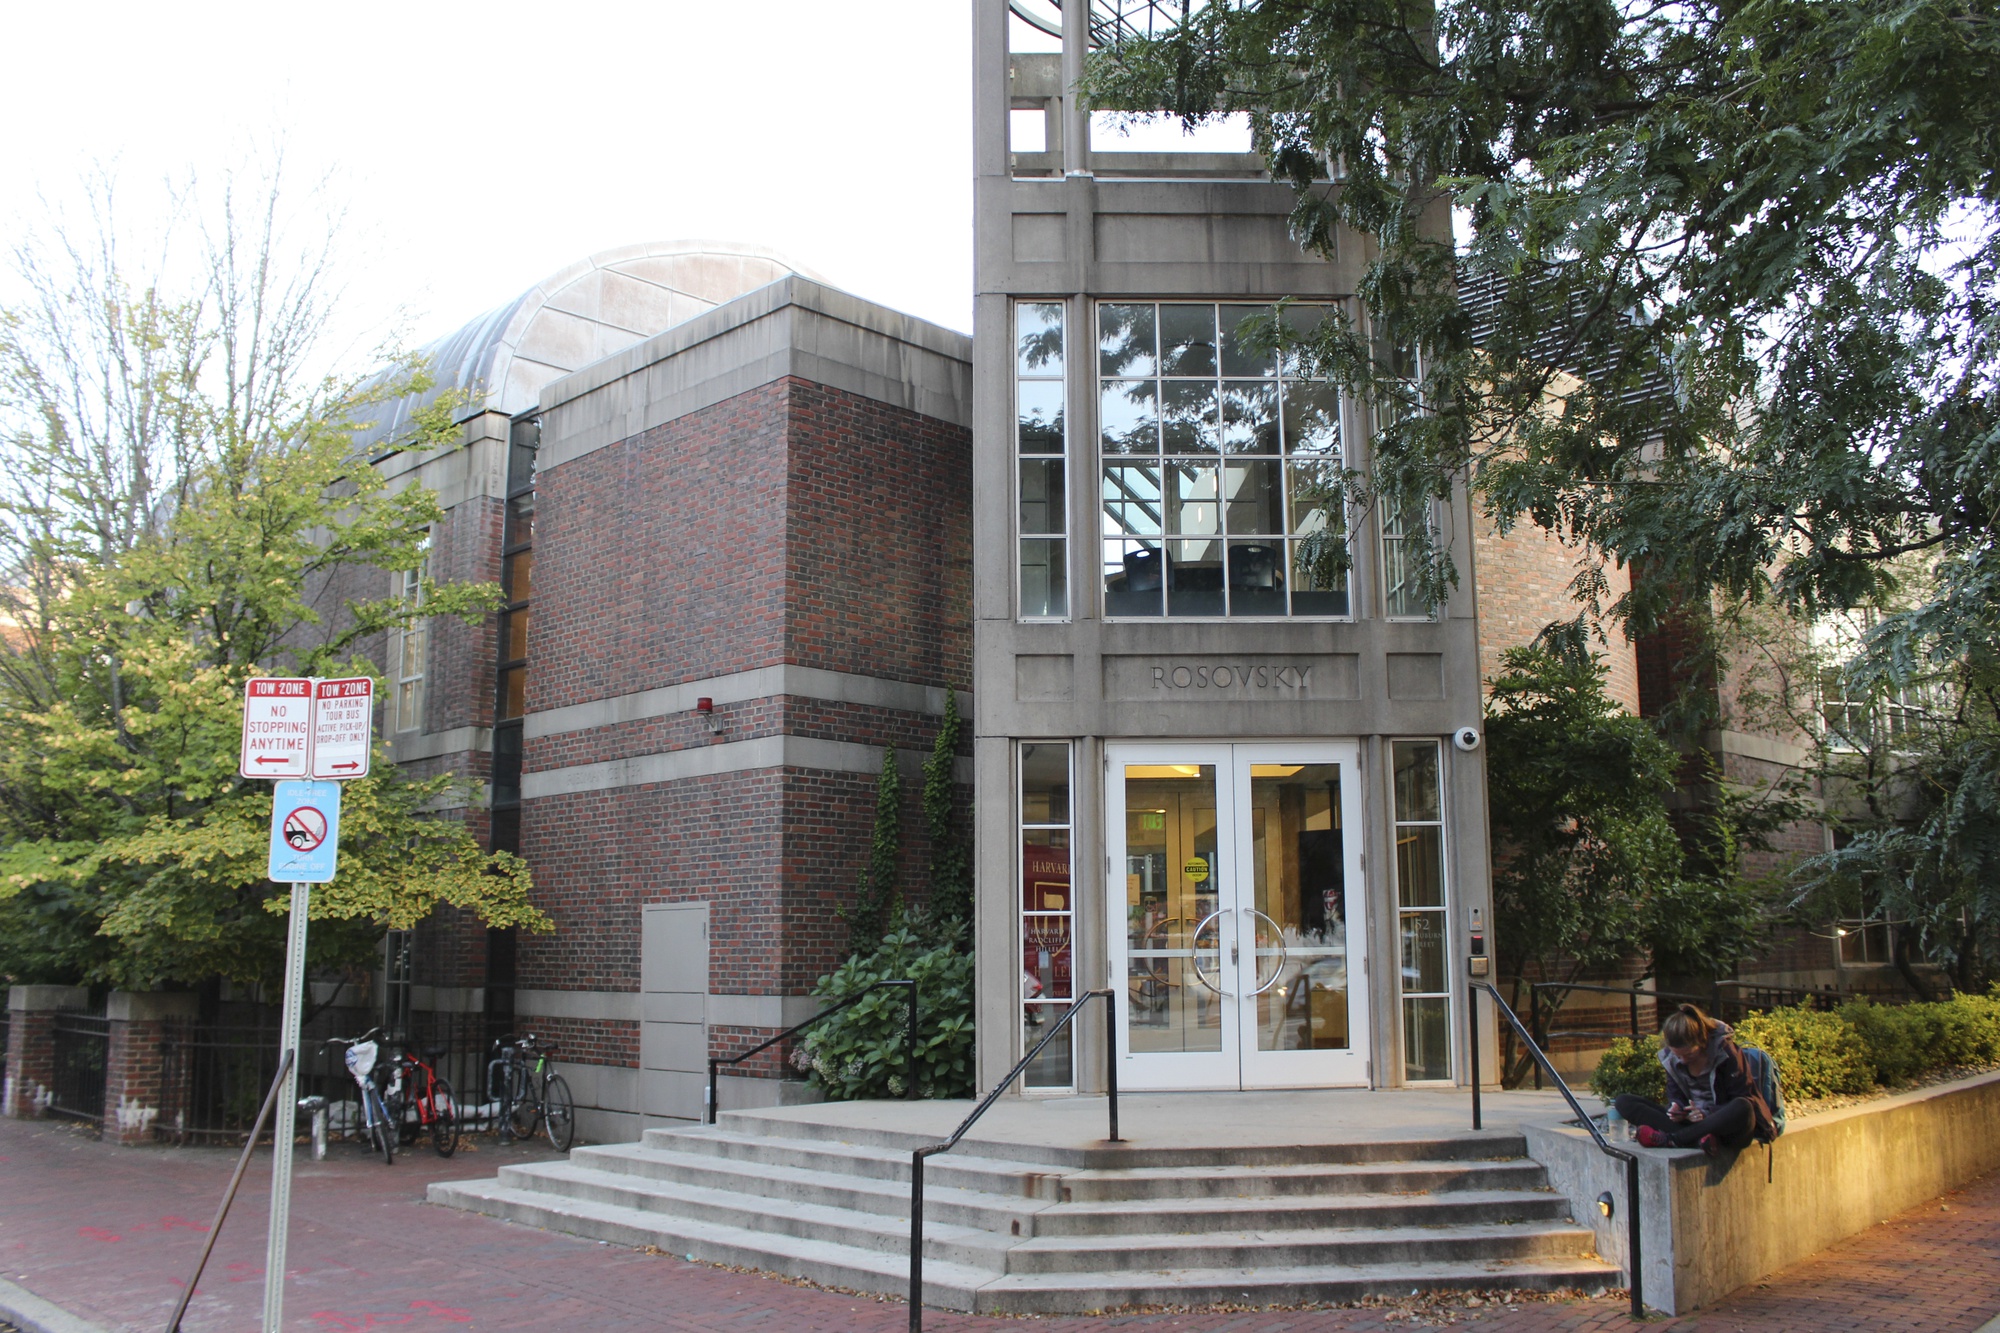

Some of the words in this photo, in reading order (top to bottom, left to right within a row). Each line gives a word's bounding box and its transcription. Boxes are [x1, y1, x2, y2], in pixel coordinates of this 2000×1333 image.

[1151, 665, 1313, 689] ROSOVSKY
[256, 682, 276, 695] TOW
[279, 682, 305, 695] ZONE
[321, 683, 340, 697] TOW
[344, 682, 368, 696] ZONE
[322, 699, 332, 710] NO
[334, 698, 364, 709] PARKING
[271, 705, 287, 718] NO
[326, 710, 344, 721] TOUR
[346, 708, 360, 720] BUS
[317, 722, 337, 733] ACTIVE
[249, 738, 305, 750] ANYTIME
[316, 734, 346, 744] DROP-OFF
[349, 732, 365, 742] ONLY
[309, 863, 326, 871] OFF
[1033, 861, 1071, 874] HARVAR
[1415, 919, 1429, 930] 52
